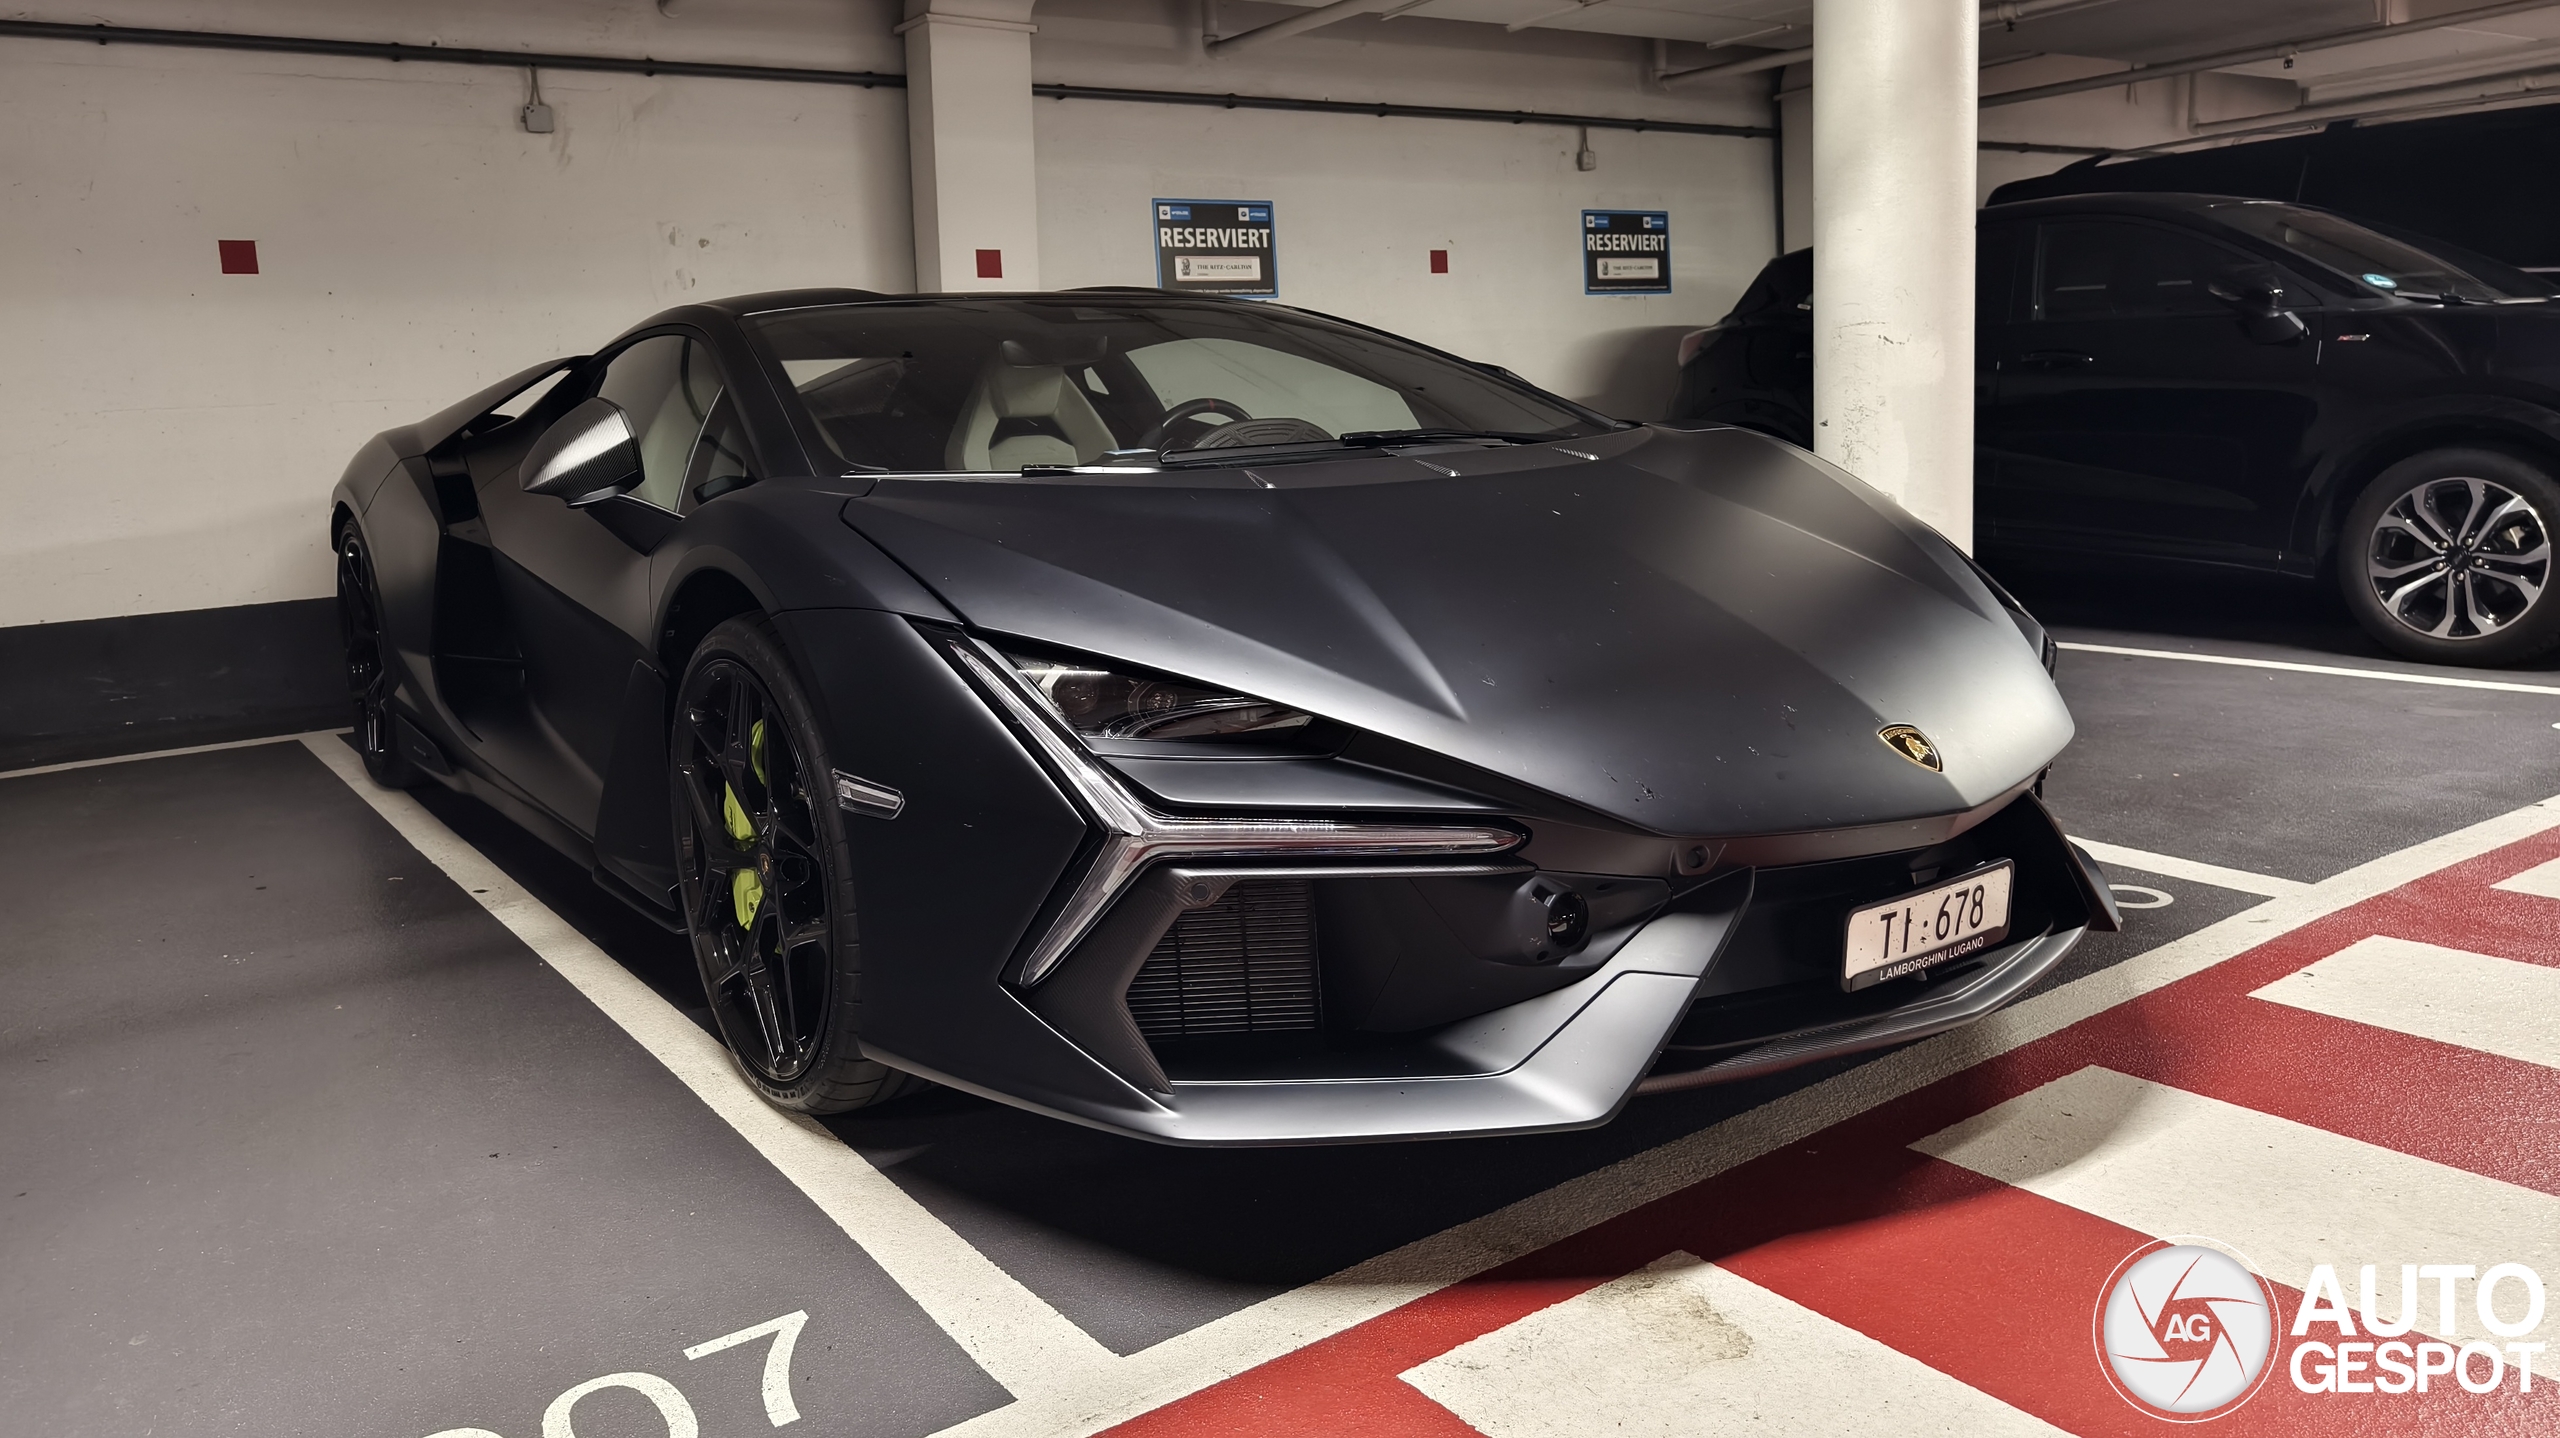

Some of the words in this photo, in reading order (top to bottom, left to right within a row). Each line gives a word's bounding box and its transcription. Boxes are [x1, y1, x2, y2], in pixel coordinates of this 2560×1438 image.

[1160, 227, 1270, 248] RESERVIERT
[1586, 233, 1666, 251] RESERVIERT
[1879, 949, 1947, 981] LAMBORGHINI
[1949, 936, 1984, 959] LUGANO
